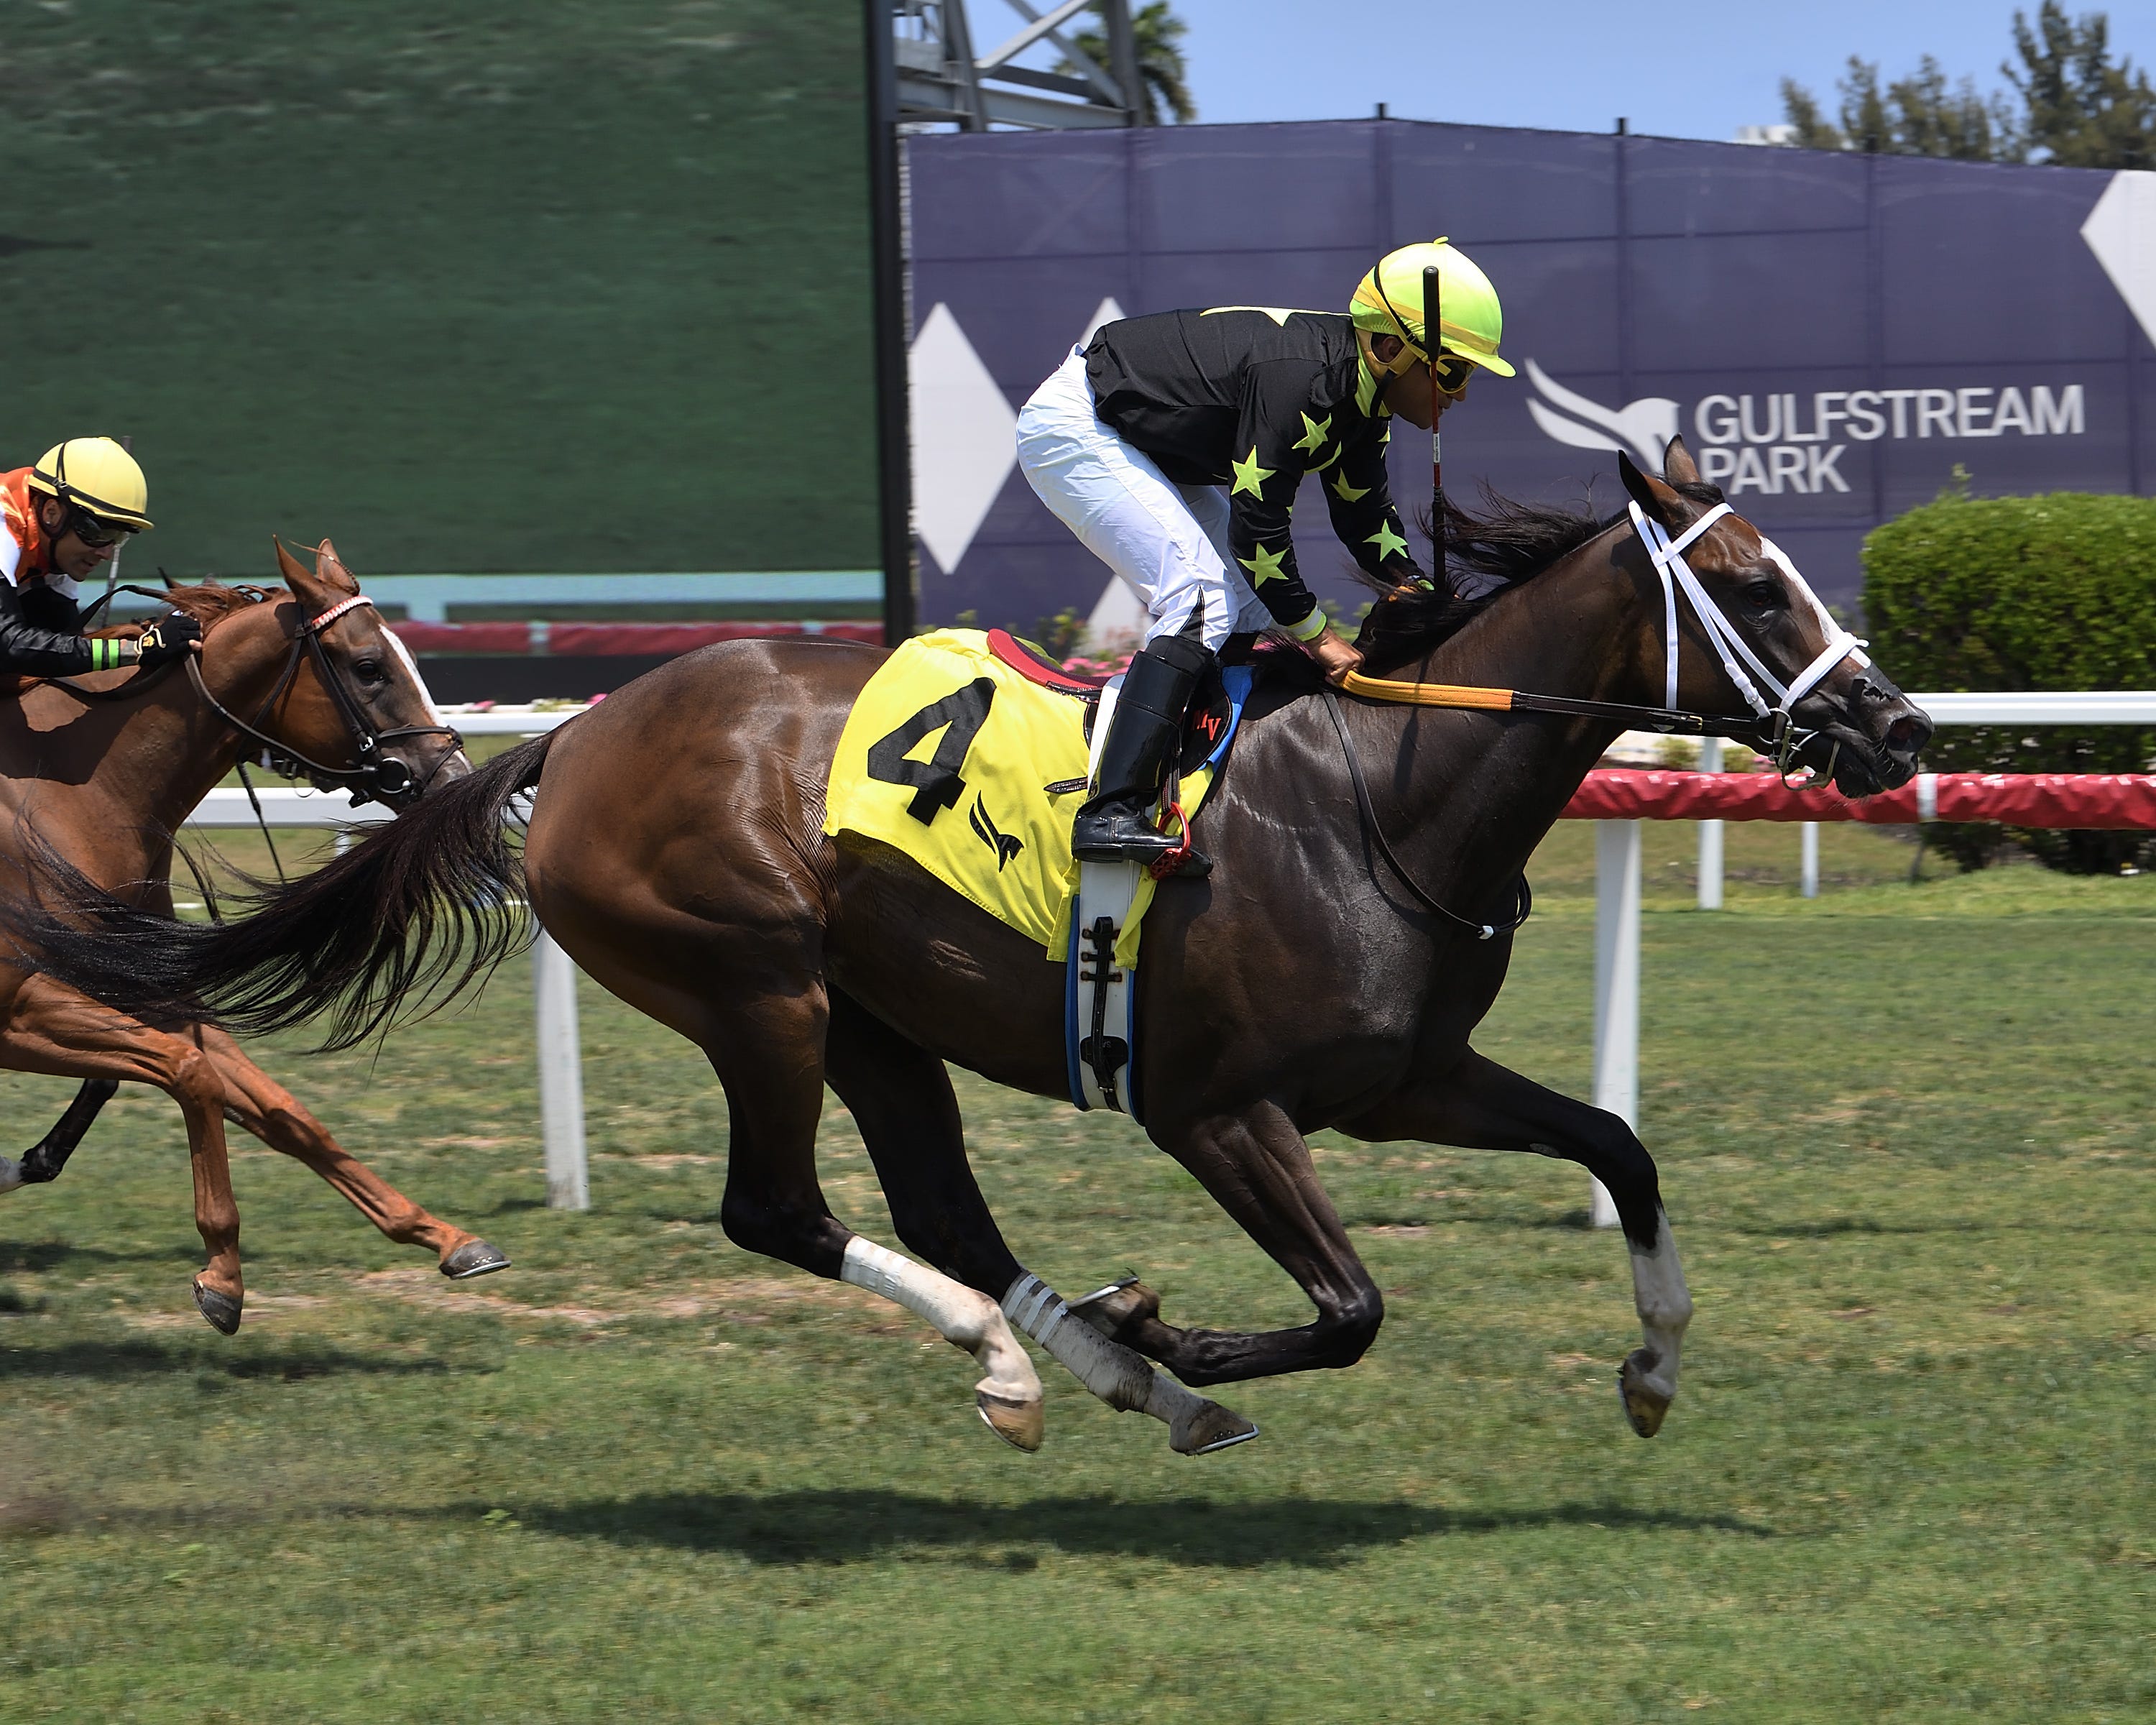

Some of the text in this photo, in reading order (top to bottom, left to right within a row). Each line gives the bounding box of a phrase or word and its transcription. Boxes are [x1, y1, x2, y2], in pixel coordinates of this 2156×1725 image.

[1694, 384, 2085, 445] GULFSTREAM
[1699, 444, 1852, 496] PARK
[867, 676, 998, 827] 4
